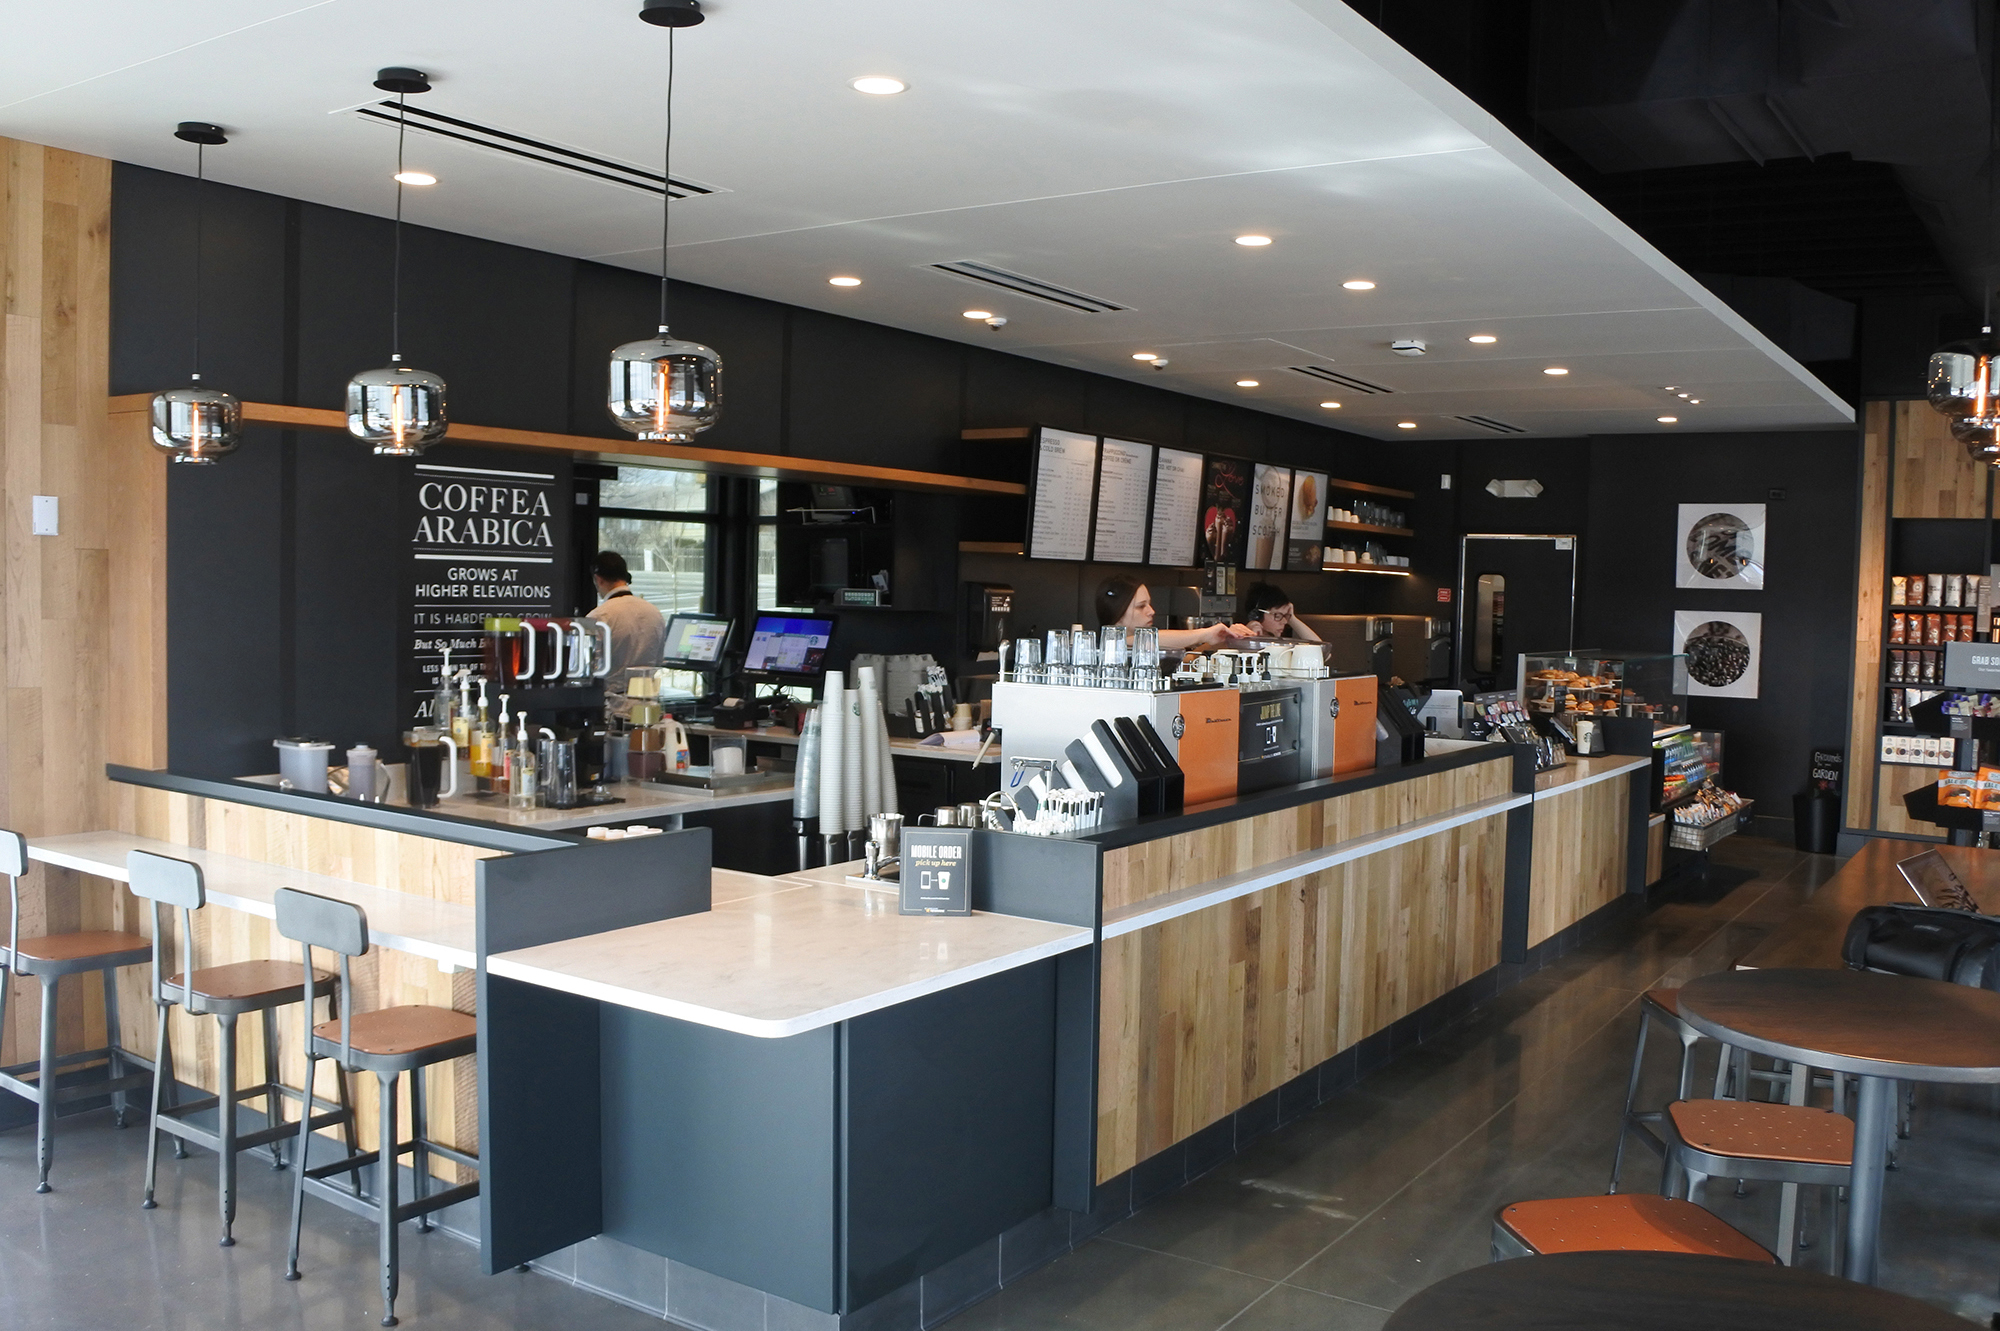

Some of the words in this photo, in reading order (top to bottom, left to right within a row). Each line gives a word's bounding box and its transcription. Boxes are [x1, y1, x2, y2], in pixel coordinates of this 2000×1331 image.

[1255, 484, 1285, 498] SMOKED
[418, 482, 552, 517] COFFEA
[1254, 505, 1282, 516] BUER
[411, 515, 554, 548] ARABICA
[447, 567, 499, 581] GROWS
[501, 568, 519, 582] AT
[415, 584, 469, 598] HIGHER
[472, 584, 552, 599] ELEVATIONS
[414, 613, 426, 625] IT
[429, 613, 441, 625] IS
[413, 638, 433, 650] But
[434, 638, 448, 650] So
[449, 638, 477, 650] Much
[1971, 655, 1989, 666] GRAB
[1990, 656, 2000, 666] SO
[422, 664, 439, 673] LESS
[911, 844, 938, 859] MOBILE
[938, 845, 962, 859] ORDER
[915, 859, 930, 867] pick
[940, 859, 957, 867] here
